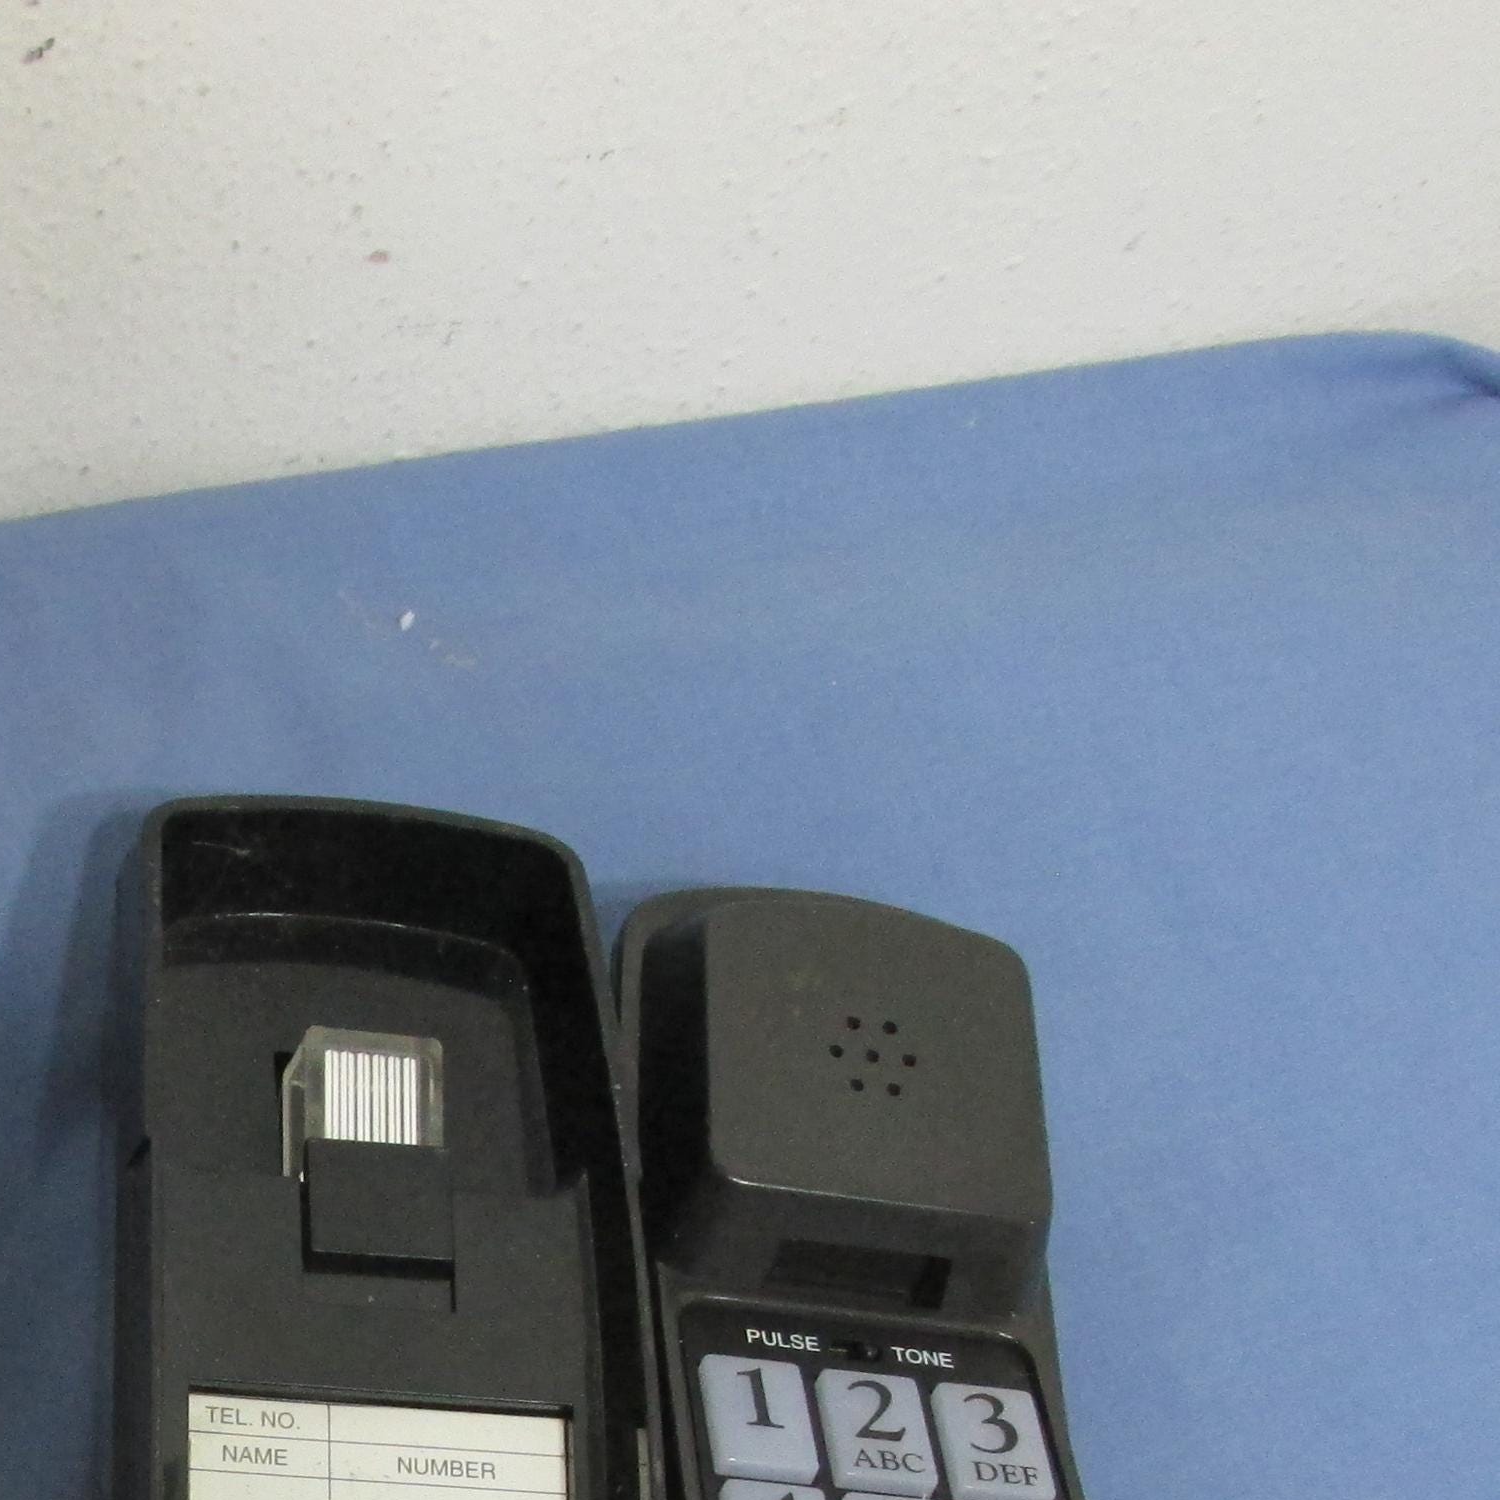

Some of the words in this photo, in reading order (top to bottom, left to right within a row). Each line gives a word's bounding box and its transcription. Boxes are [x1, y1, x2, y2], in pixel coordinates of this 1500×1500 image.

[746, 1328, 821, 1353] PULSE
[891, 1346, 955, 1370] TONE
[736, 1367, 785, 1430] 1
[847, 1380, 907, 1442] 2
[205, 1405, 253, 1427] TEL.
[261, 1410, 301, 1430] NO.
[963, 1392, 1019, 1454] 3
[221, 1444, 288, 1466] NAME
[854, 1449, 926, 1474] ABC
[397, 1456, 497, 1480] NUMBER
[974, 1461, 1038, 1486] DEF
